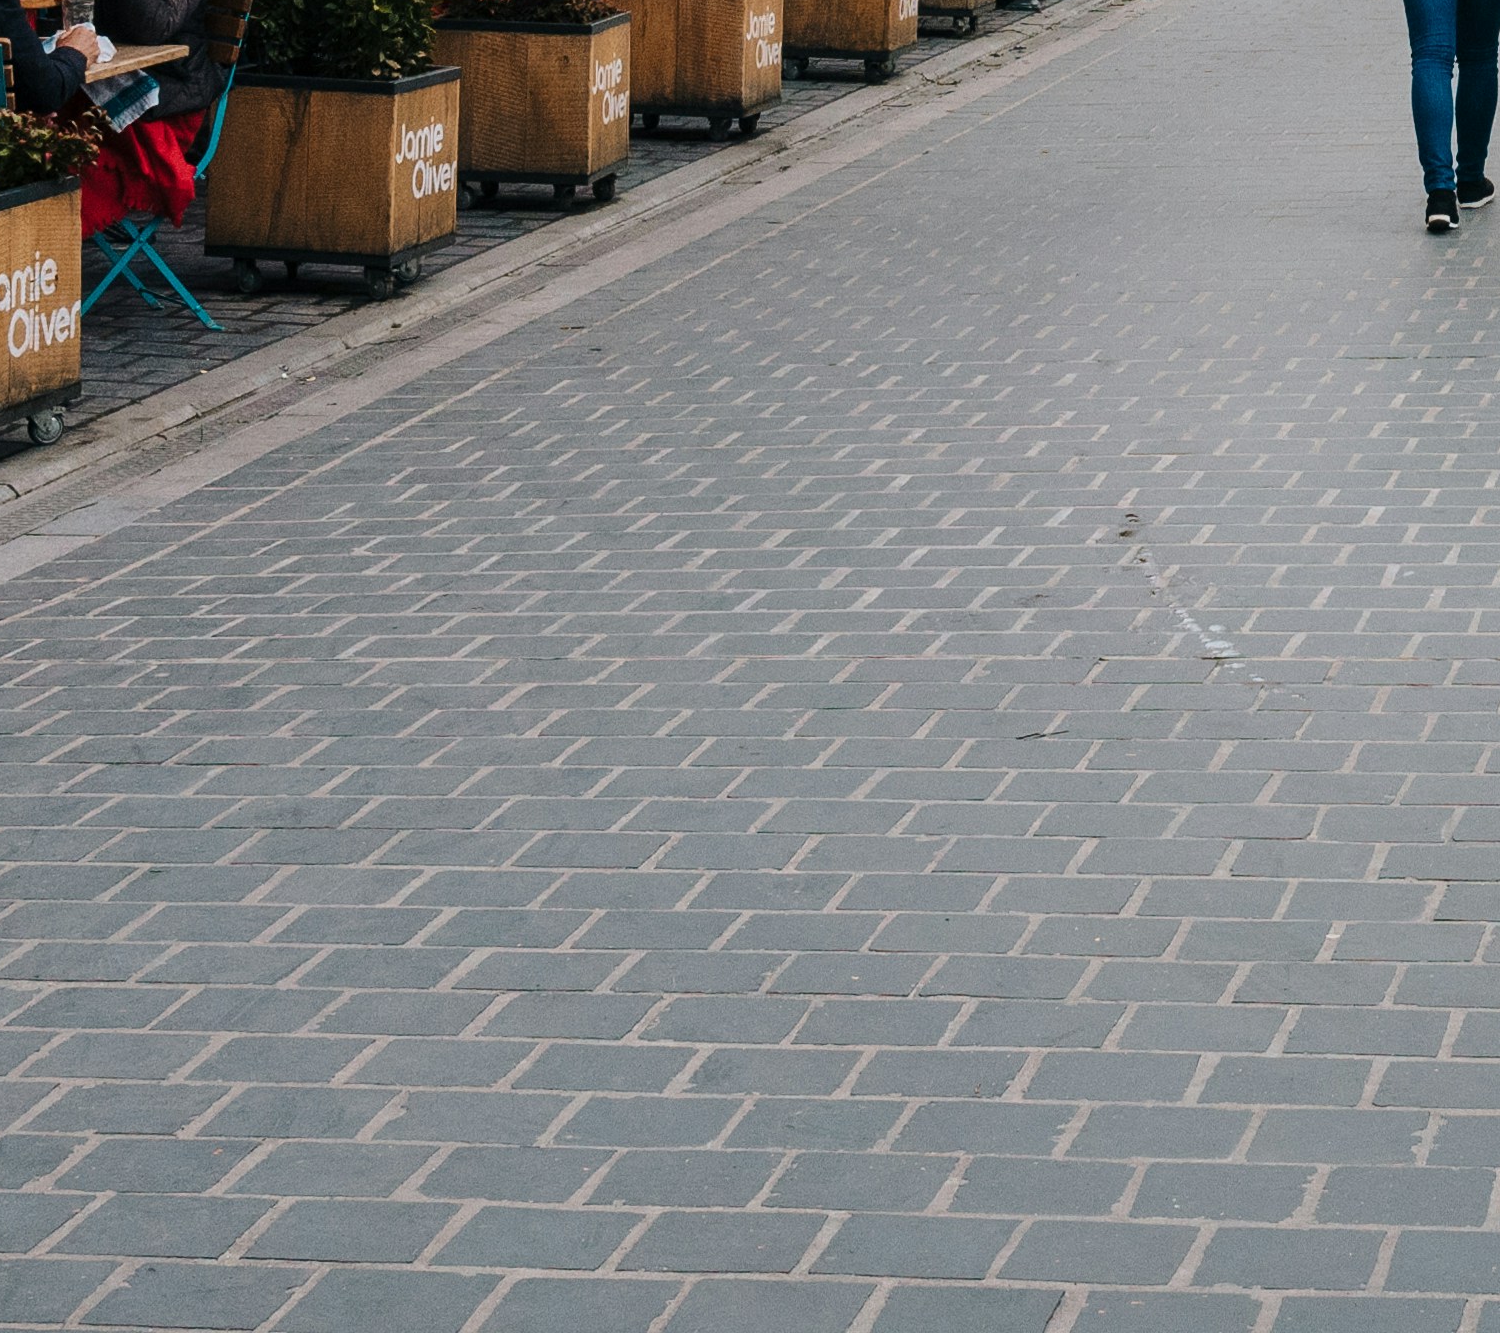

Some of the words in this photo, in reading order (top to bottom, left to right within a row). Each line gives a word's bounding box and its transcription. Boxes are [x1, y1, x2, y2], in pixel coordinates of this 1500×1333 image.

[746, 5, 775, 41] Jamie
[591, 52, 623, 95] Jamie
[602, 89, 630, 125] Oliver
[395, 115, 444, 165] Jamie
[412, 159, 458, 200] Oliver
[7, 299, 82, 358] Oliver
